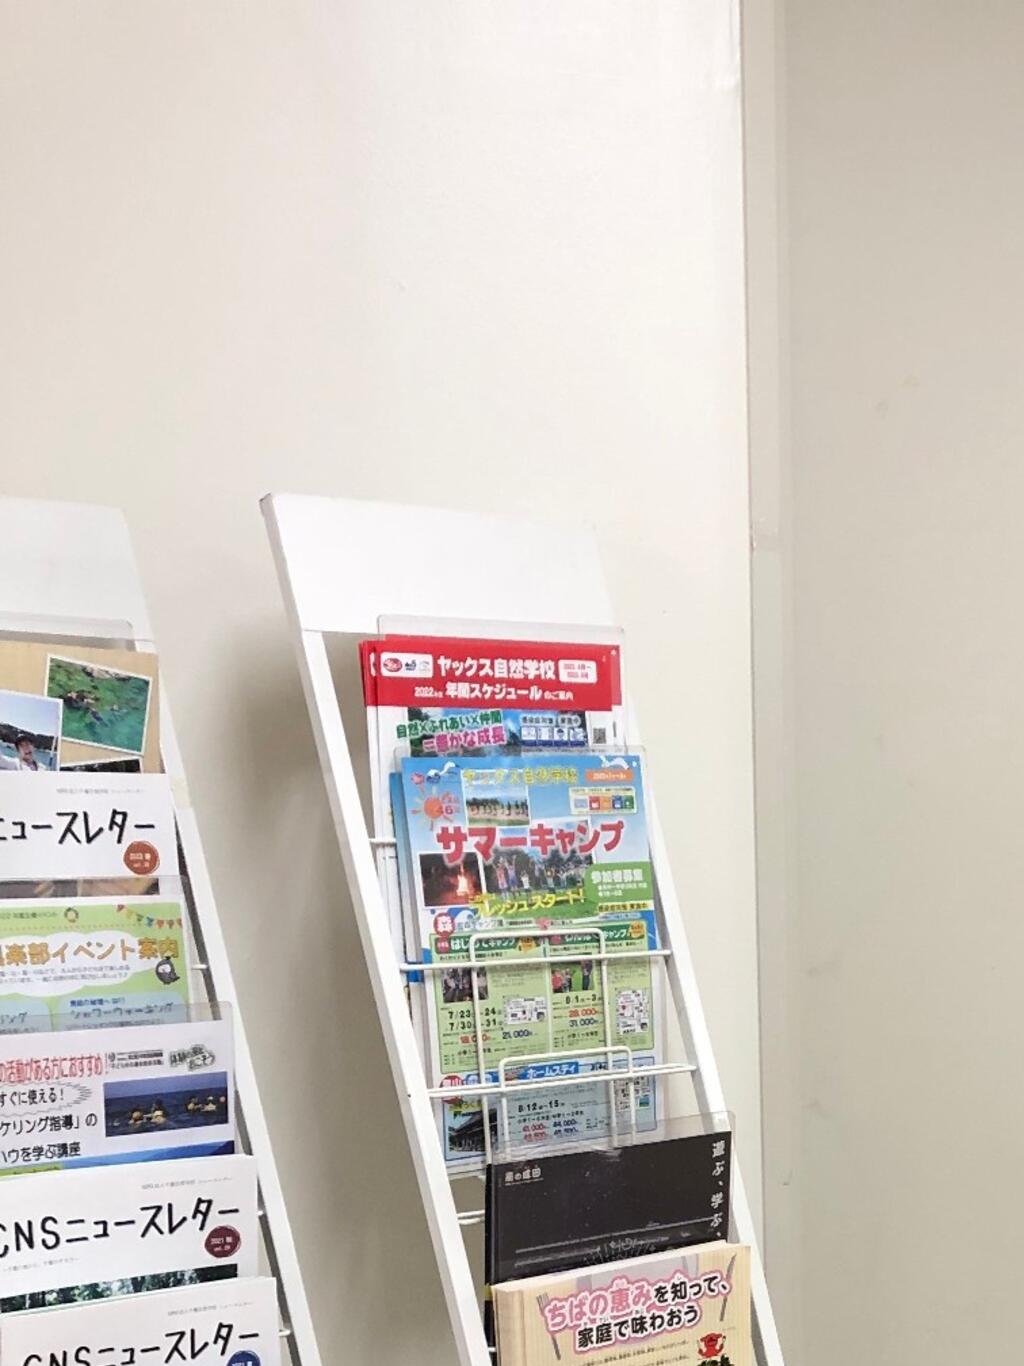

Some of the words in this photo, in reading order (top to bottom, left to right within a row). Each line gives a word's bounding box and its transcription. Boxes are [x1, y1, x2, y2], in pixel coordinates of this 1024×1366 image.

[438, 656, 554, 680] ヤックス自然学校
[436, 821, 625, 865] サマーキャンプ
[0, 937, 179, 966] 楽部イベント案内
[526, 1064, 577, 1079] ホームステイ
[547, 1275, 729, 1328] ちばの恵みを知って、
[578, 1305, 698, 1348] 家庭で味わおう
